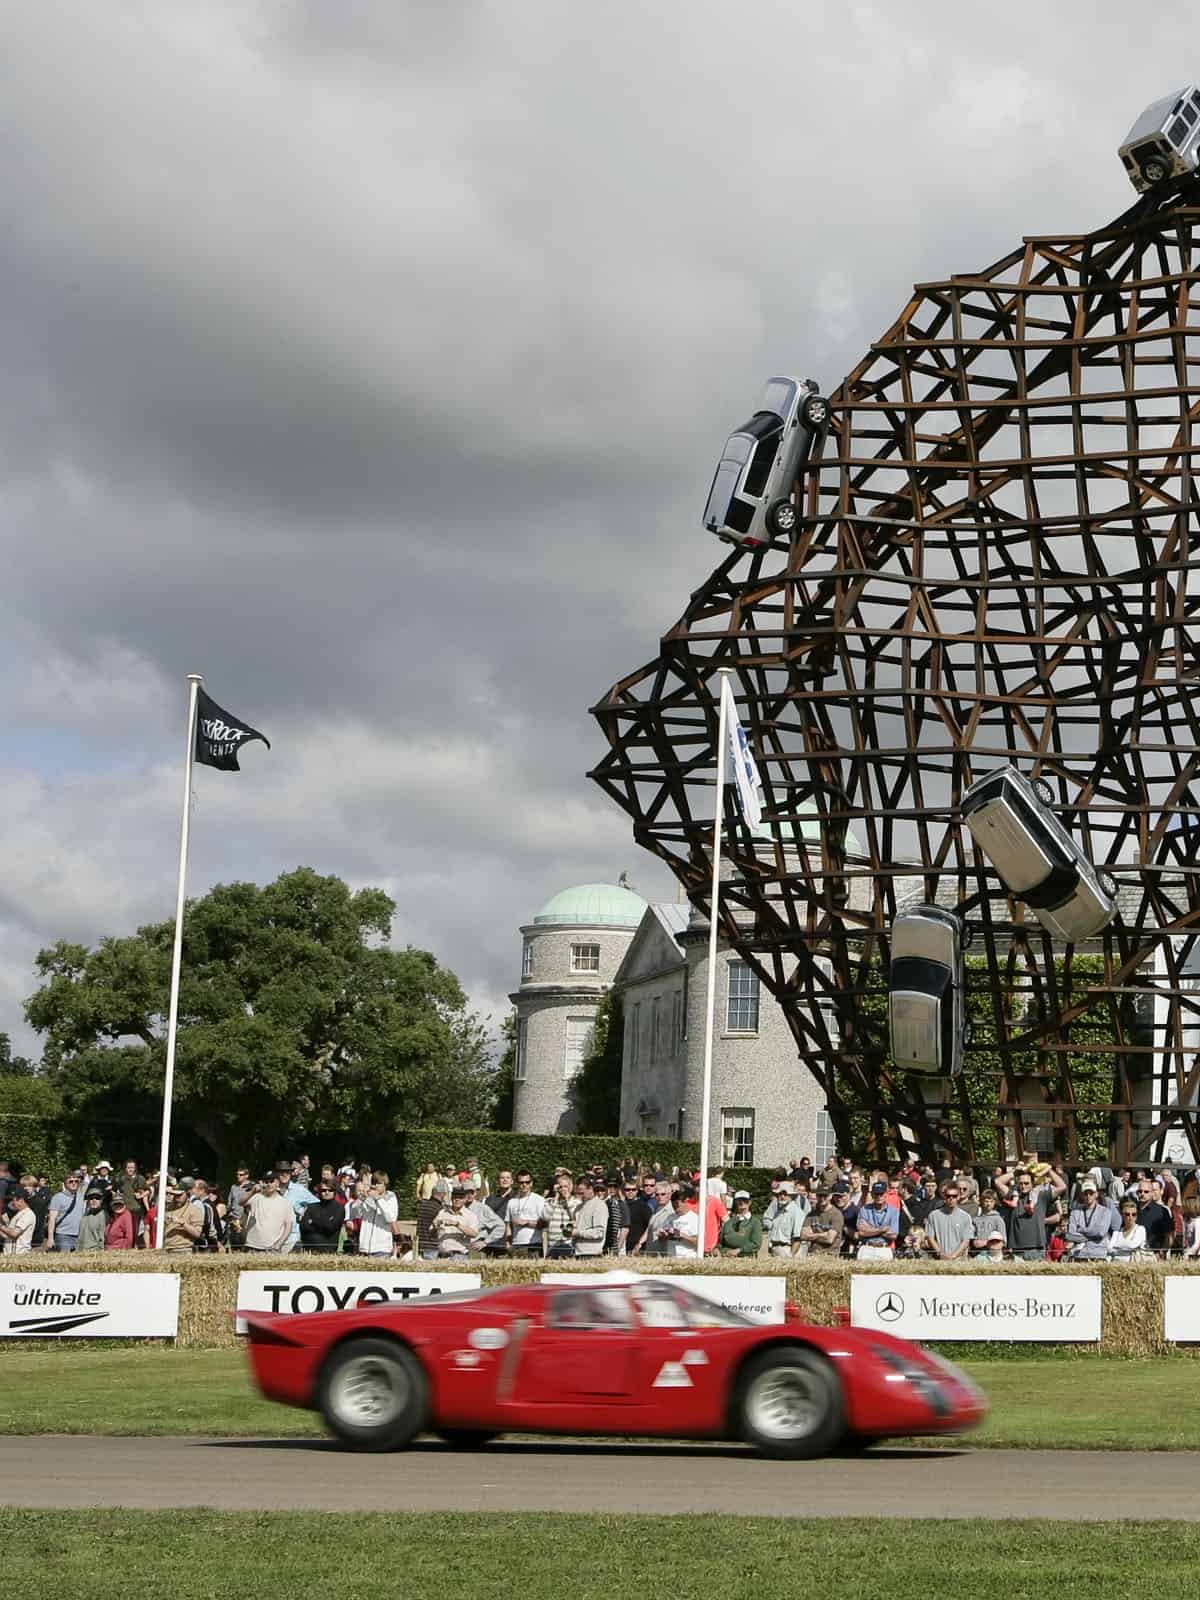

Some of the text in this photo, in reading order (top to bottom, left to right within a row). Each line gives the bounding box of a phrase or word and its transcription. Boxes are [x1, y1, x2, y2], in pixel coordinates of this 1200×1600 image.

[14, 1288, 102, 1306] ultimate
[263, 1285, 443, 1314] TOYOT
[919, 1298, 1076, 1318] Mercedes-Benz
